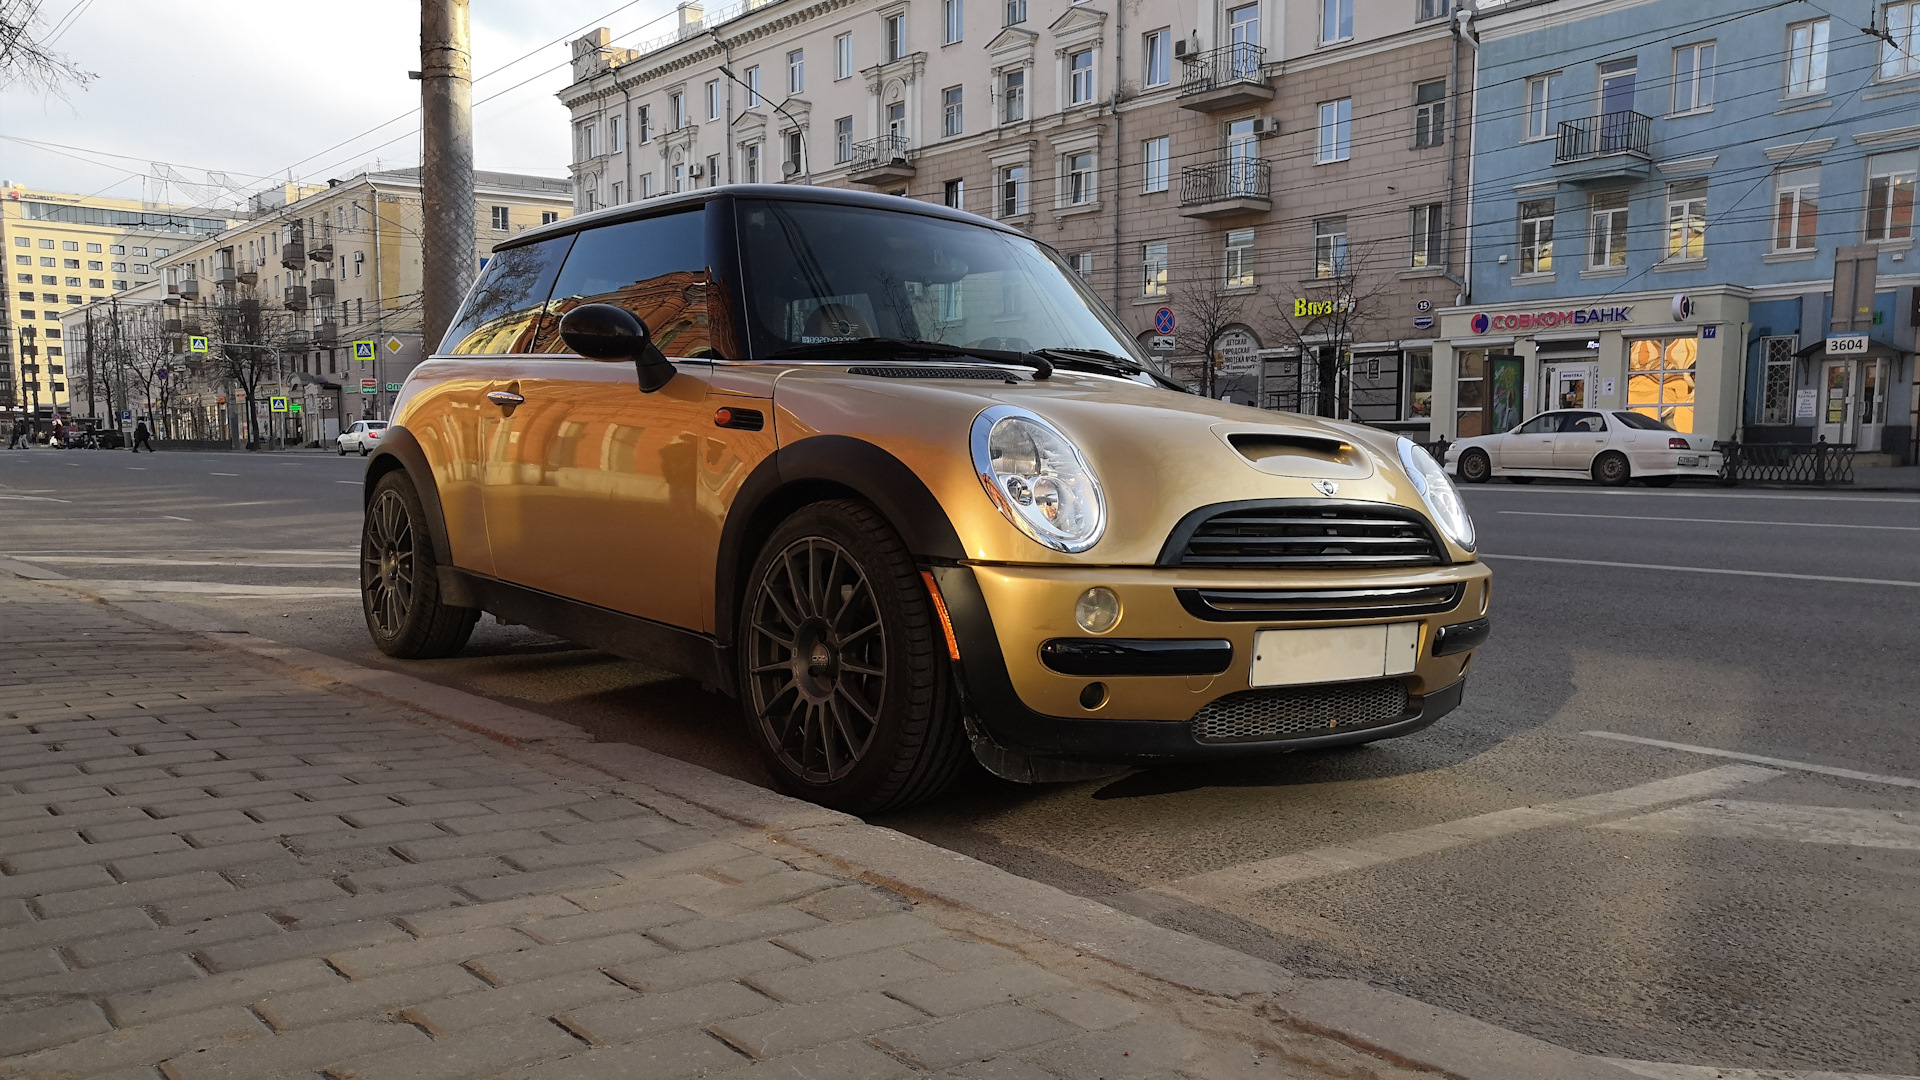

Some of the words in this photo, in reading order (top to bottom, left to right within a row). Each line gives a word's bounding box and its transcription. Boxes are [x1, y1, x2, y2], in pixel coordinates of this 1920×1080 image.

[1420, 302, 1428, 310] 15
[1493, 305, 1633, 331] СОВКОМБАНК
[1704, 328, 1715, 336] 17
[1830, 339, 1863, 351] 3604
